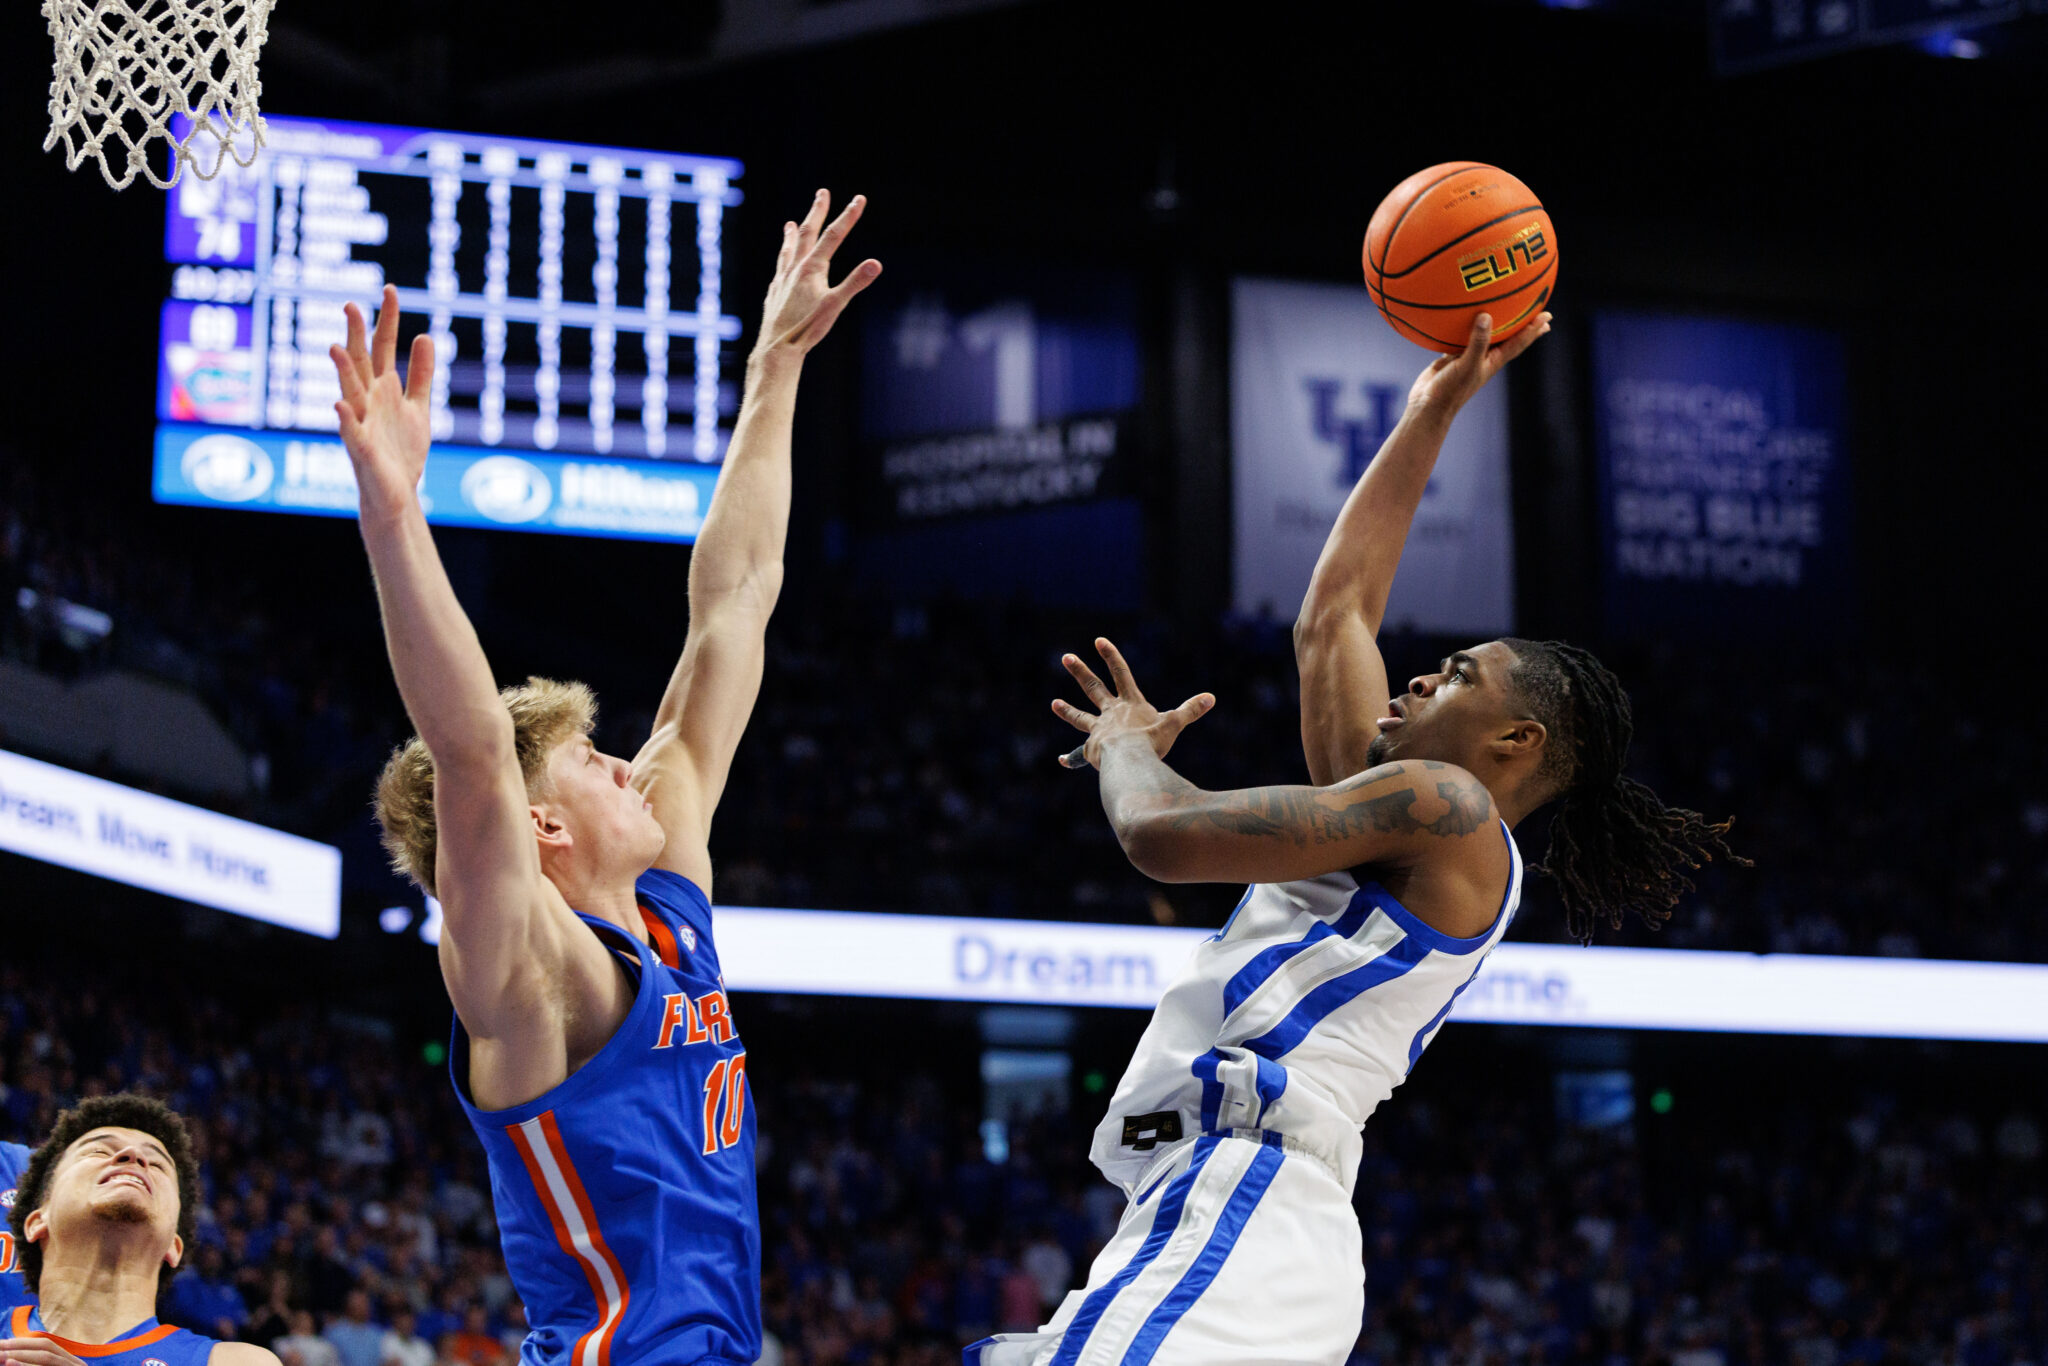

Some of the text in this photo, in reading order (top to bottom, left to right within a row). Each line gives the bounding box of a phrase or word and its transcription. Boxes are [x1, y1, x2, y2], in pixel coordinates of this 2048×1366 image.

[1459, 228, 1548, 291] ELITE
[1616, 494, 1820, 546] BIG BLUE
[1618, 538, 1801, 585] NATION
[703, 1051, 746, 1156] 10
